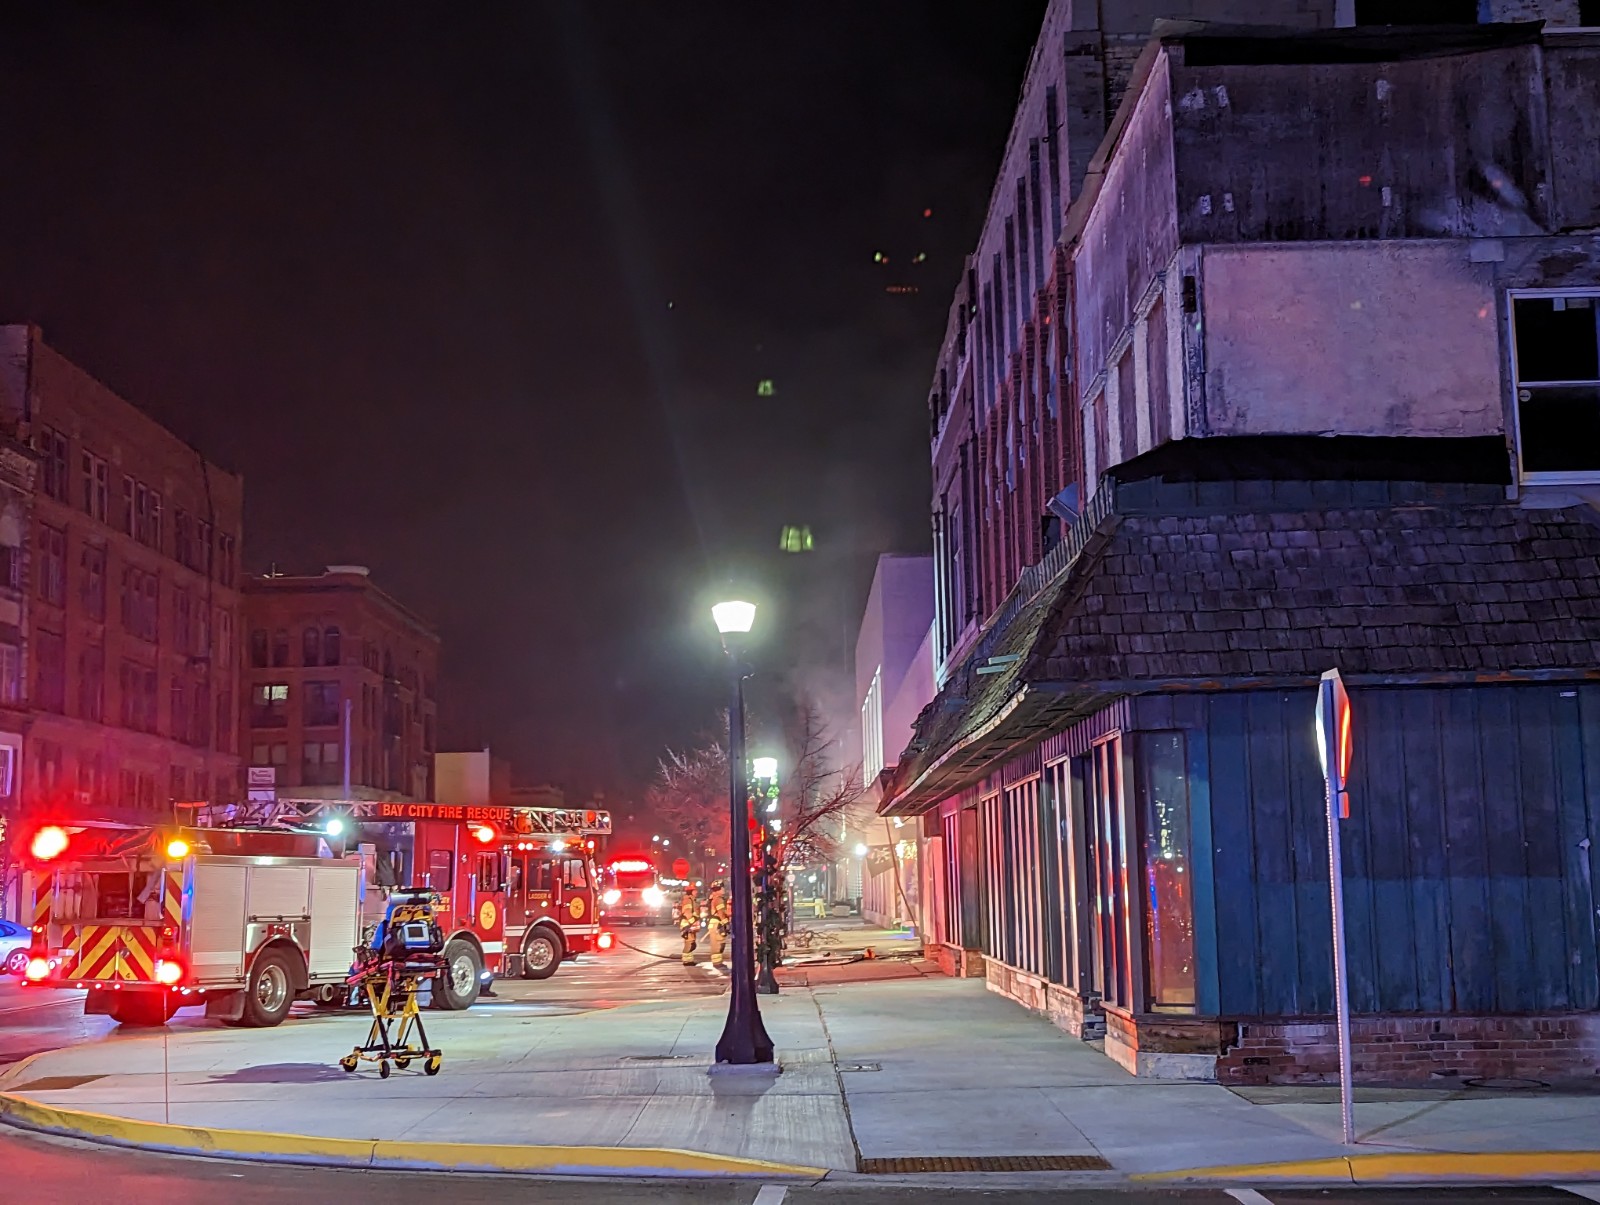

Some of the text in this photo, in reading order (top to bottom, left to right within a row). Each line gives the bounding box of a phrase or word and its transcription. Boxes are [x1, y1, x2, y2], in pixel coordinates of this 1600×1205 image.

[383, 804, 511, 820] BAY CITY FIRE RESCUE
